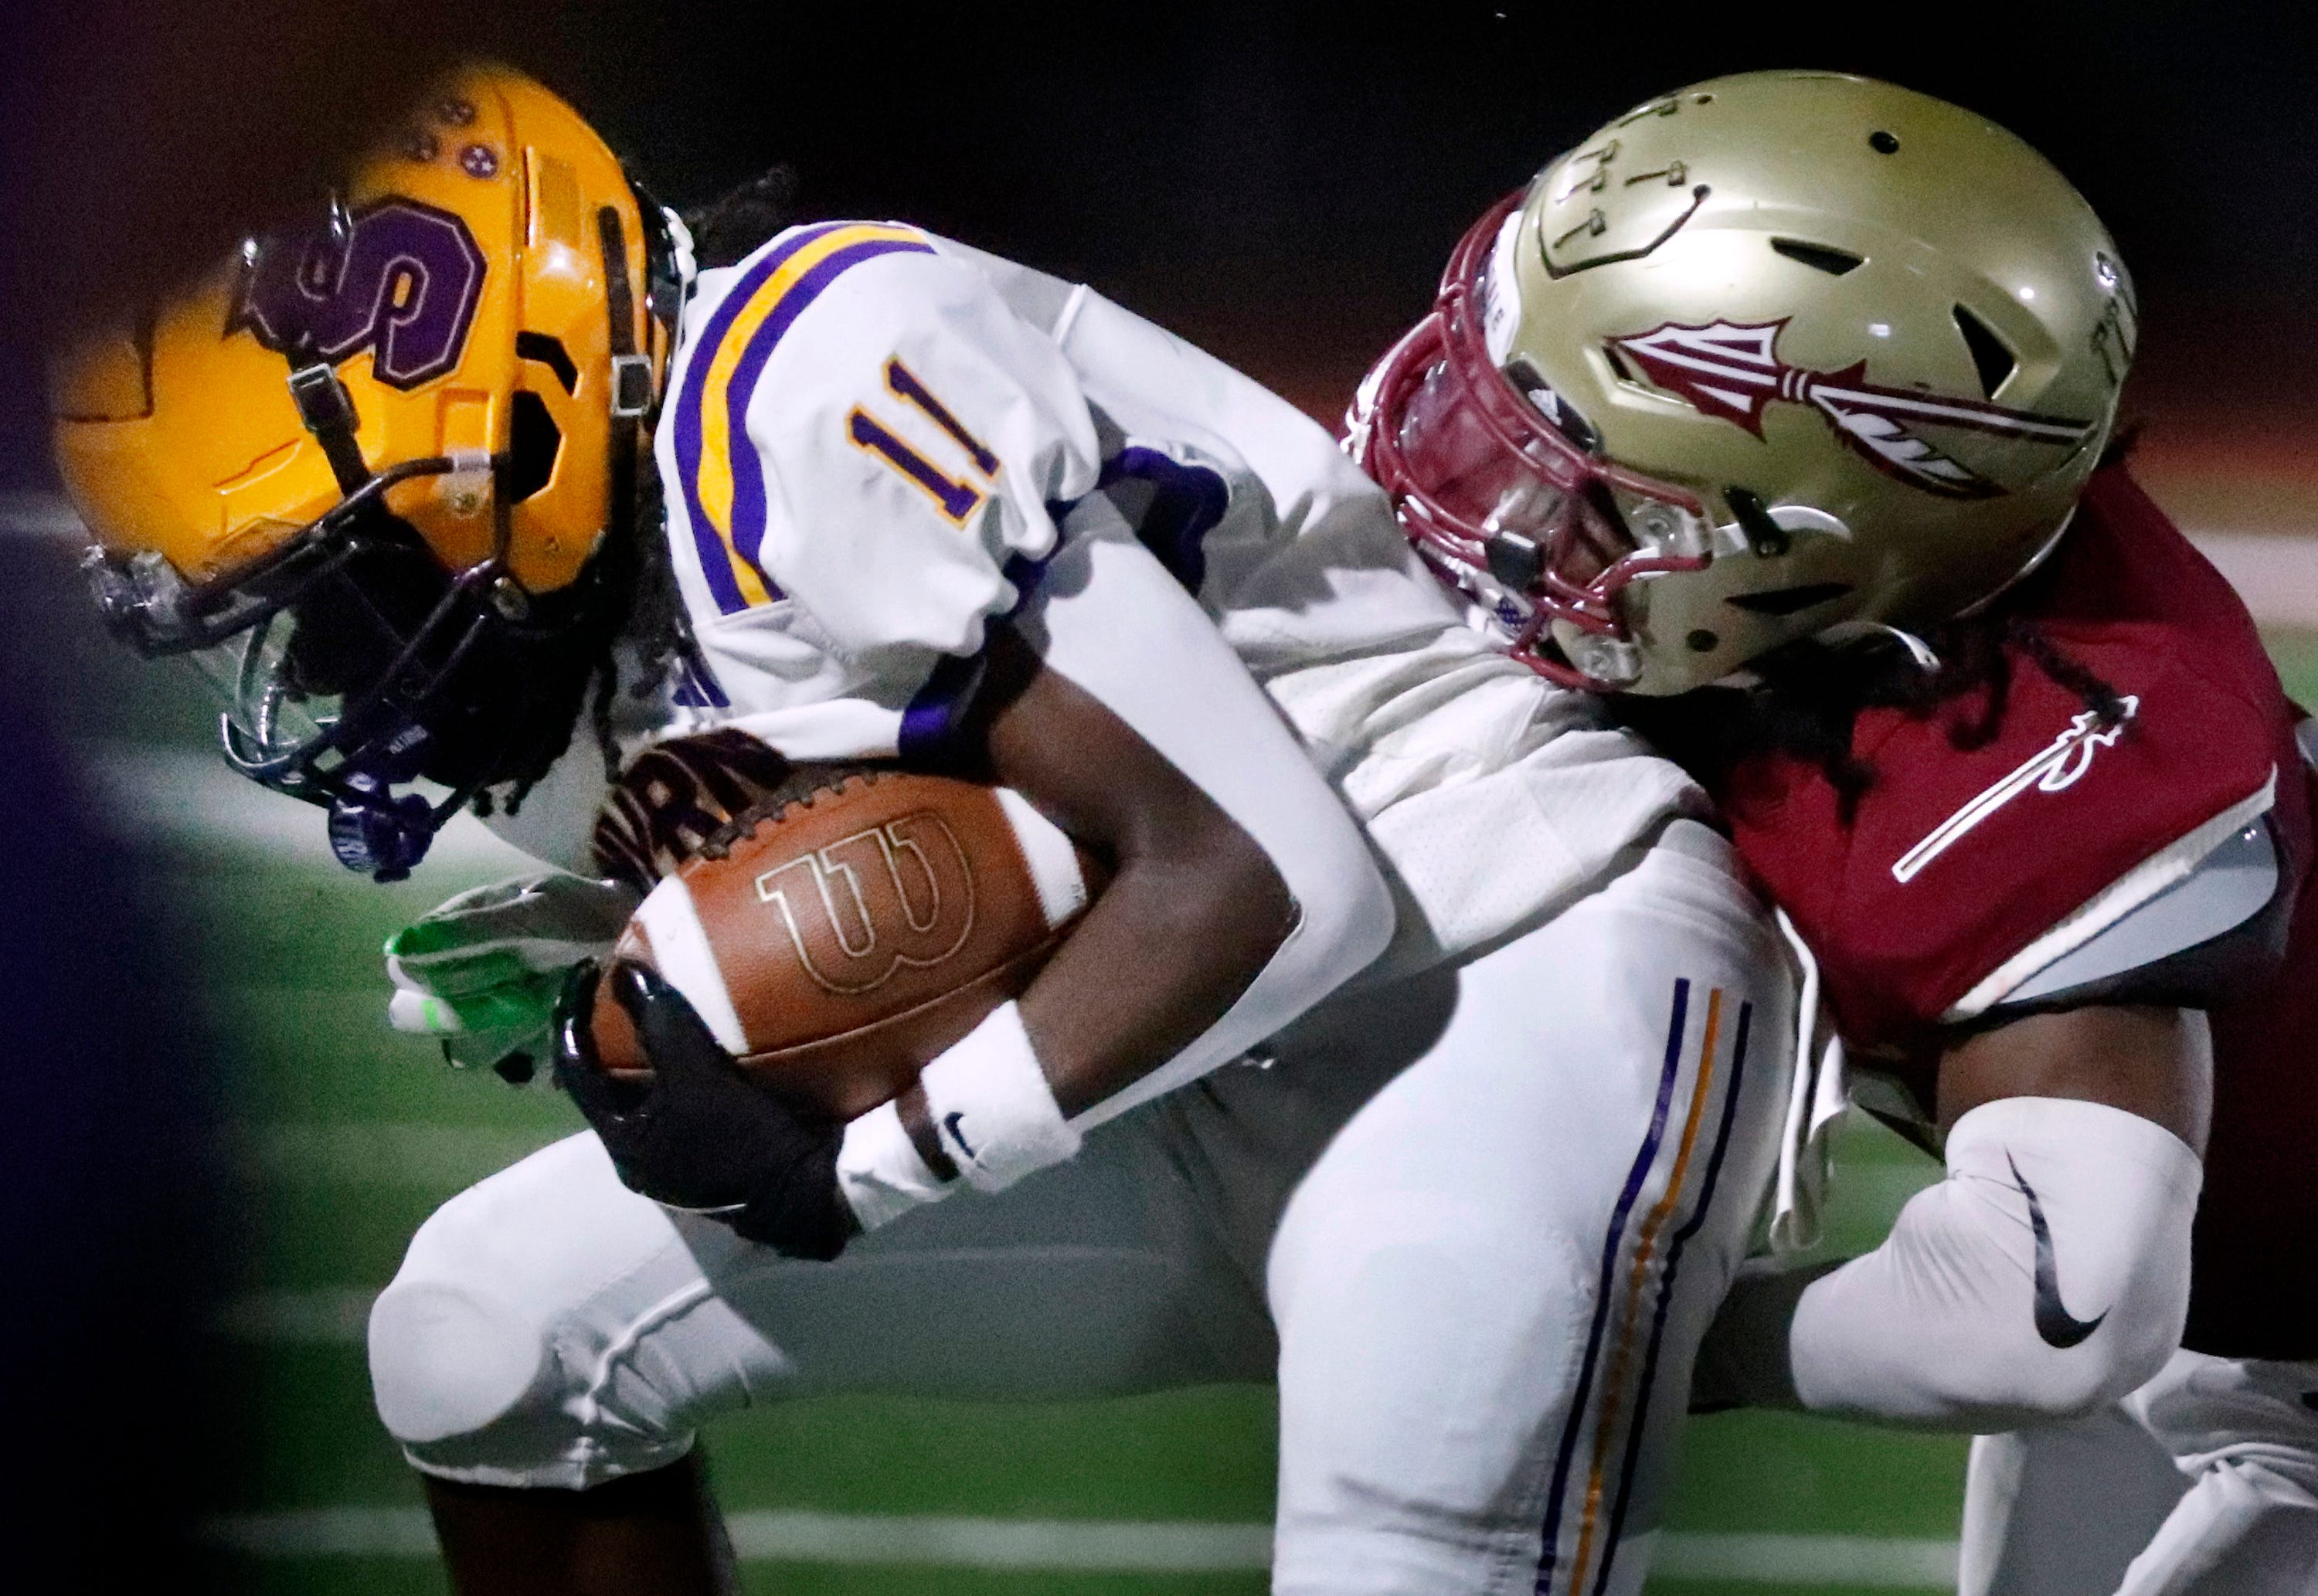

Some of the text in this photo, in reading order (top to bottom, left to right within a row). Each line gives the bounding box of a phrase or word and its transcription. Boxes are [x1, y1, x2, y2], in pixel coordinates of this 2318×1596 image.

[230, 195, 488, 392] S
[845, 352, 1003, 531] 11
[754, 808, 976, 997] W
